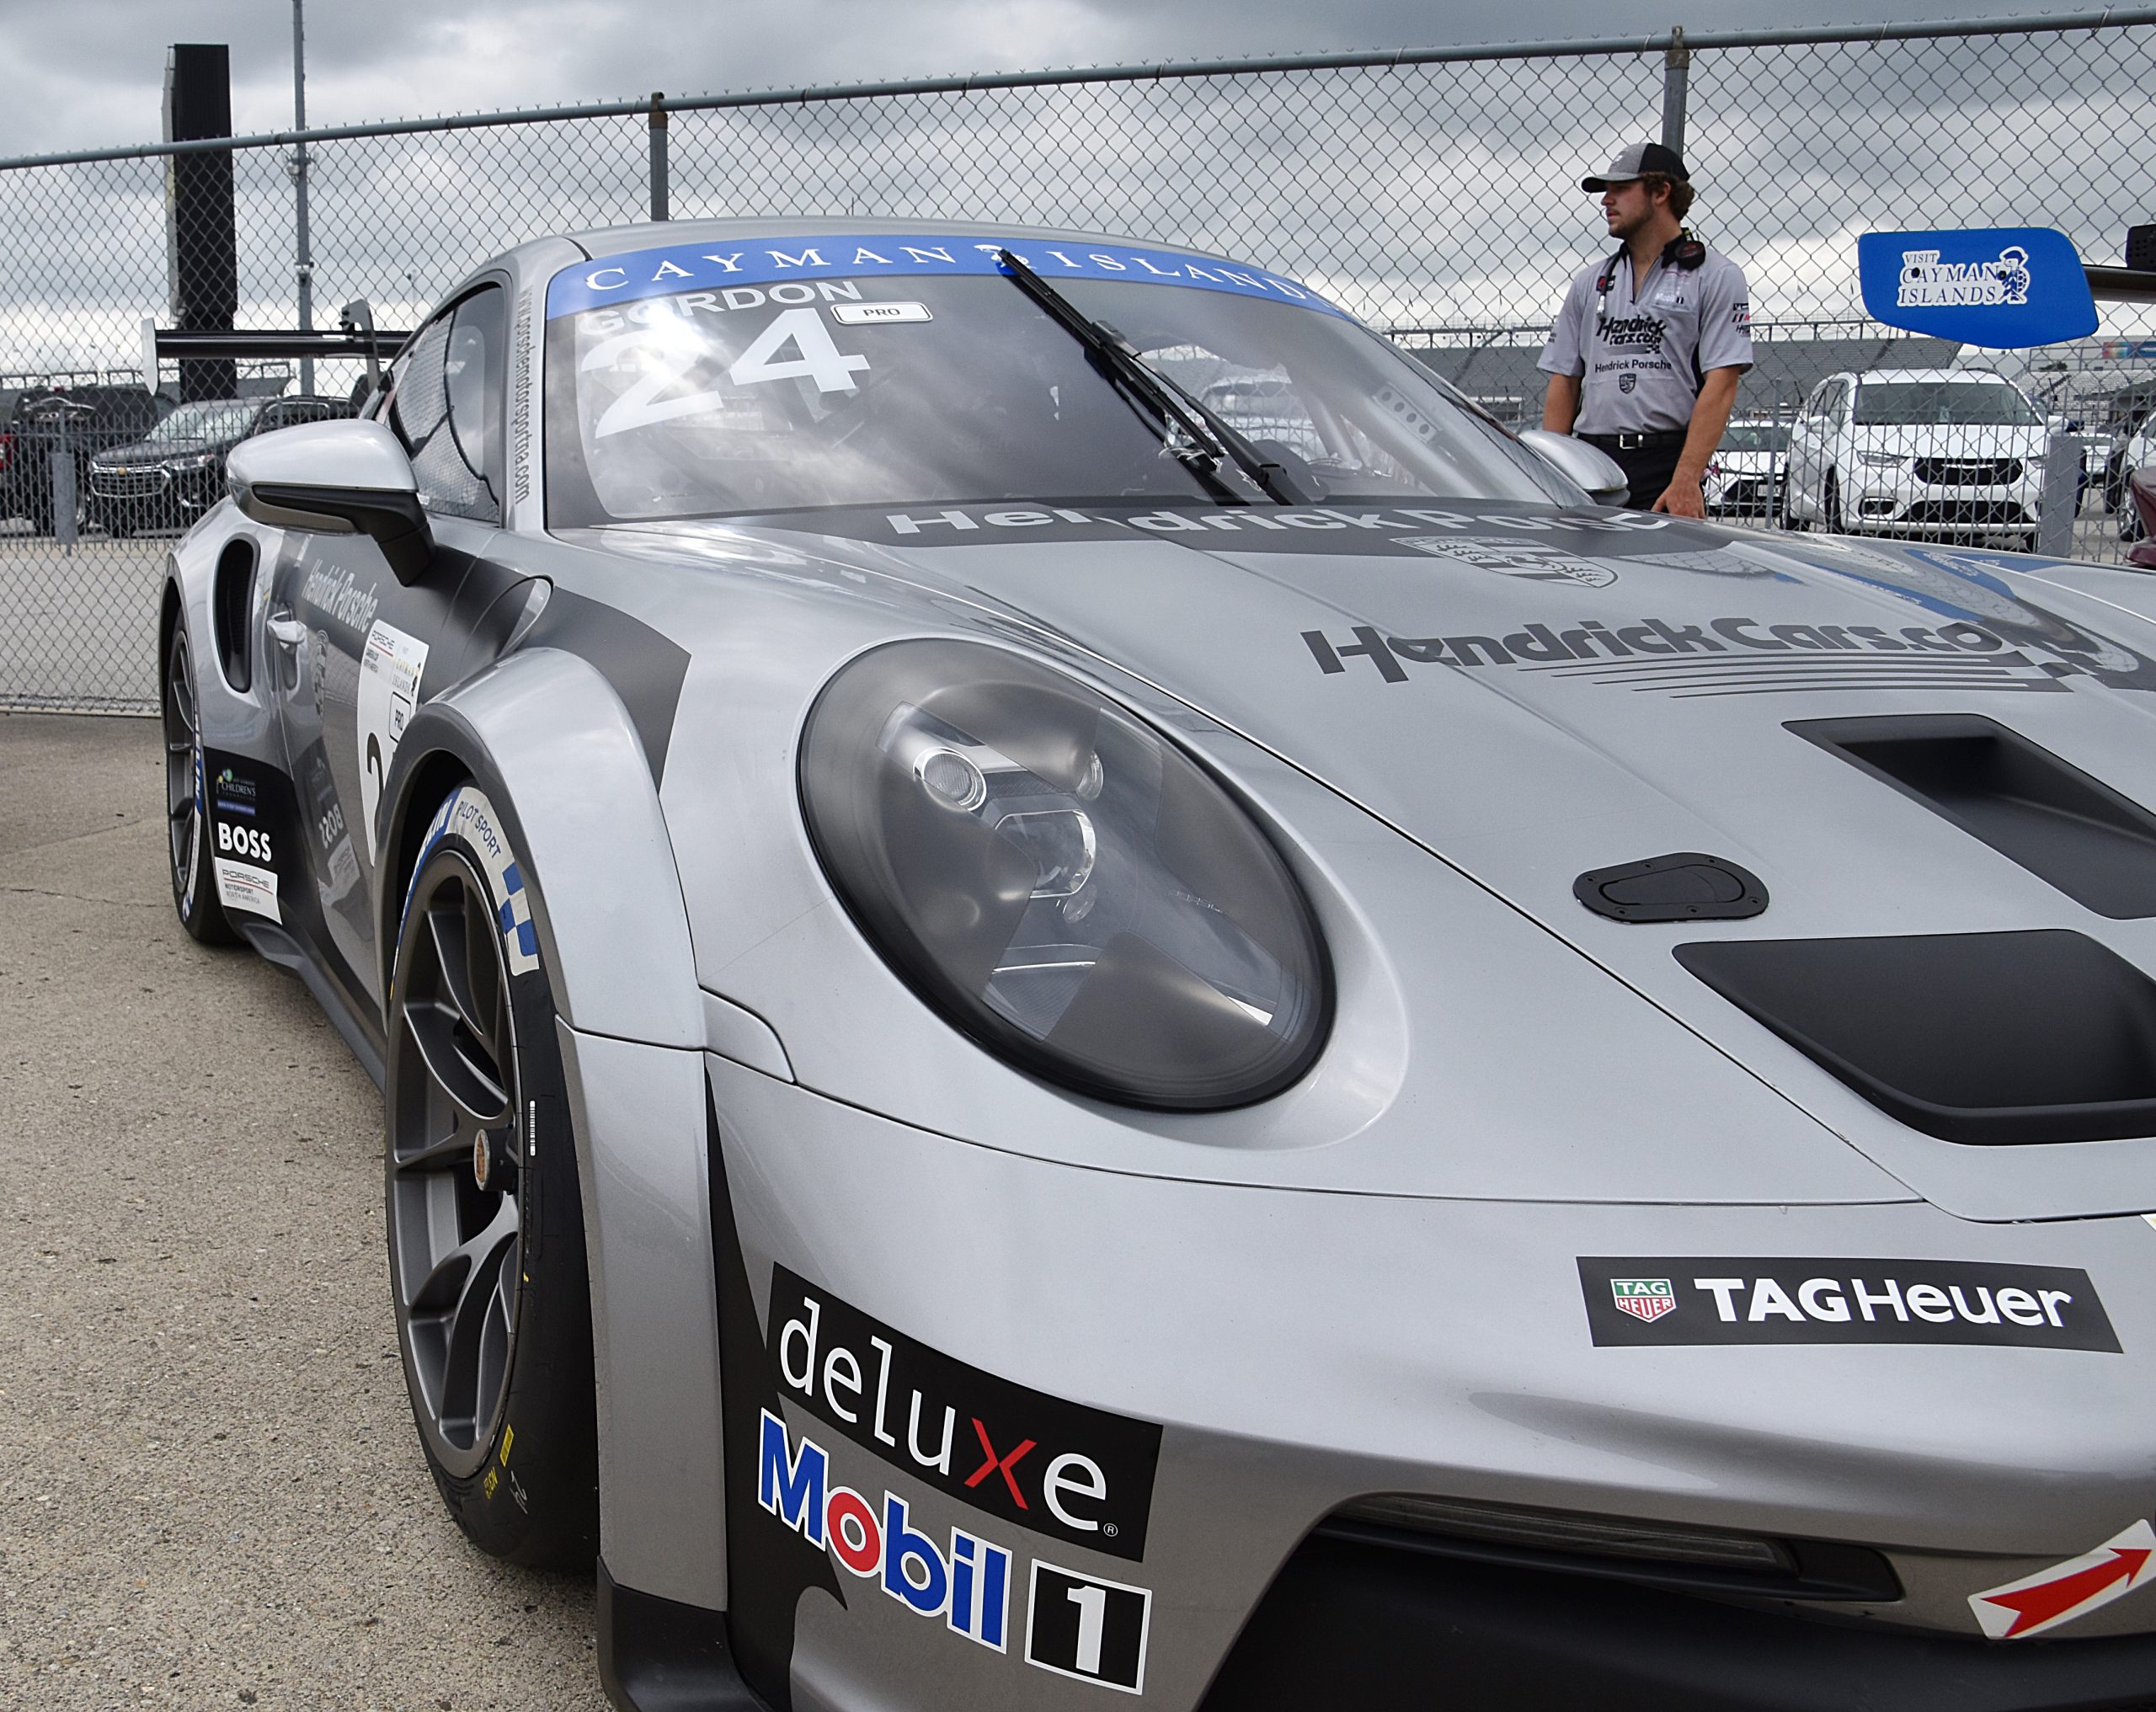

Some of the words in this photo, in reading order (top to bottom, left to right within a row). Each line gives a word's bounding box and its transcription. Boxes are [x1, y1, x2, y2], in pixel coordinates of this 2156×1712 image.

[585, 246, 956, 291] CAYMAN
[1905, 253, 1937, 264] VISIT
[1903, 265, 1999, 284] CAYMAN
[579, 281, 863, 335] GORDON
[1900, 286, 1996, 304] ISLANDS
[862, 308, 900, 317] PRO
[1596, 314, 1667, 342] Hendrick
[581, 307, 871, 439] 24
[1595, 360, 1630, 373] Hendrick
[1631, 359, 1672, 371] Porsche
[332, 573, 378, 633] Porsche
[218, 822, 272, 862] BOSS
[456, 800, 479, 823] PILOT
[475, 814, 501, 859] SPORT
[222, 868, 270, 889] PORSCHE
[1616, 1282, 1668, 1295] TAG
[1618, 1298, 1672, 1319] HEUER
[780, 1296, 1107, 1531] deluxe
[759, 1408, 1011, 1654] Mobil
[1067, 1585, 1107, 1675] 1
